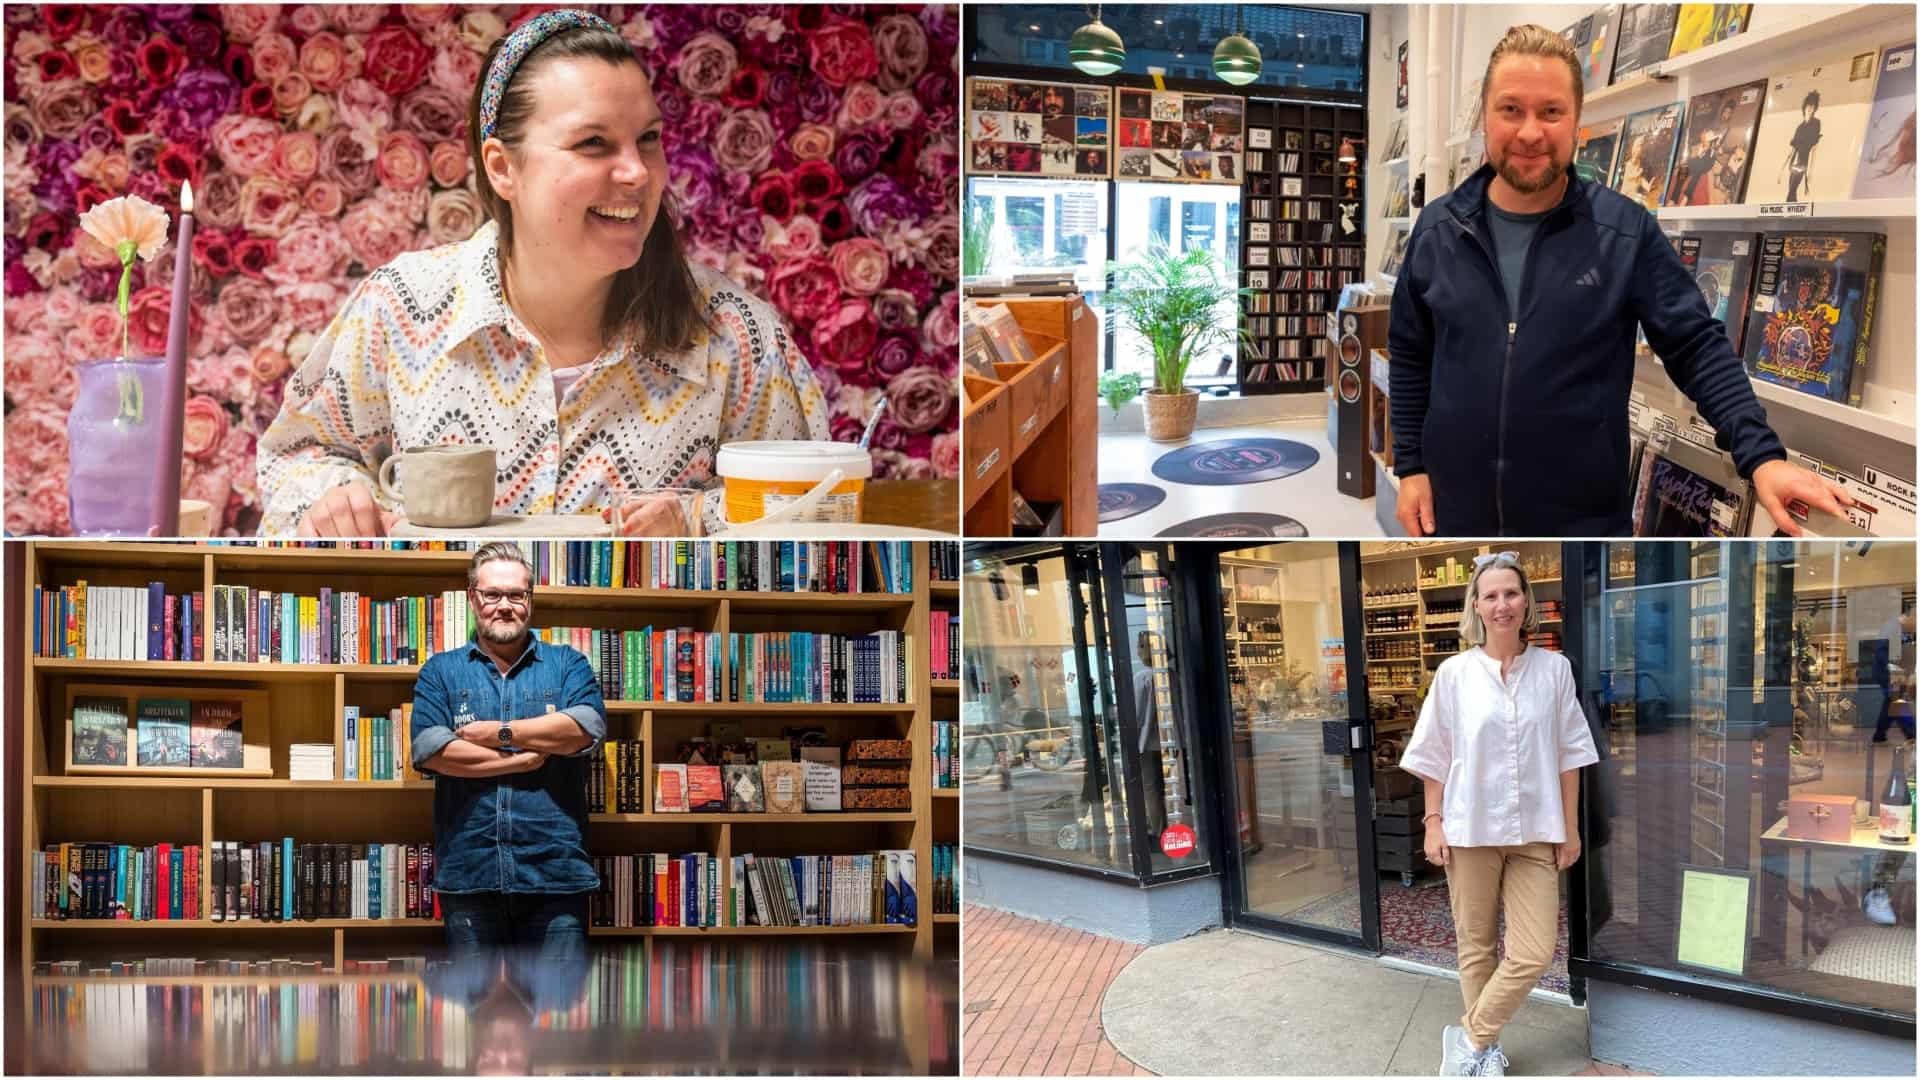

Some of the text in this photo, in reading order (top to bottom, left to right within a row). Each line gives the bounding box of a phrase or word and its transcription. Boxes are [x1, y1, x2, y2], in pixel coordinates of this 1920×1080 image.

[1252, 279, 1263, 287] 10
[1866, 470, 1876, 484] U
[1887, 481, 1907, 498] ROCK
